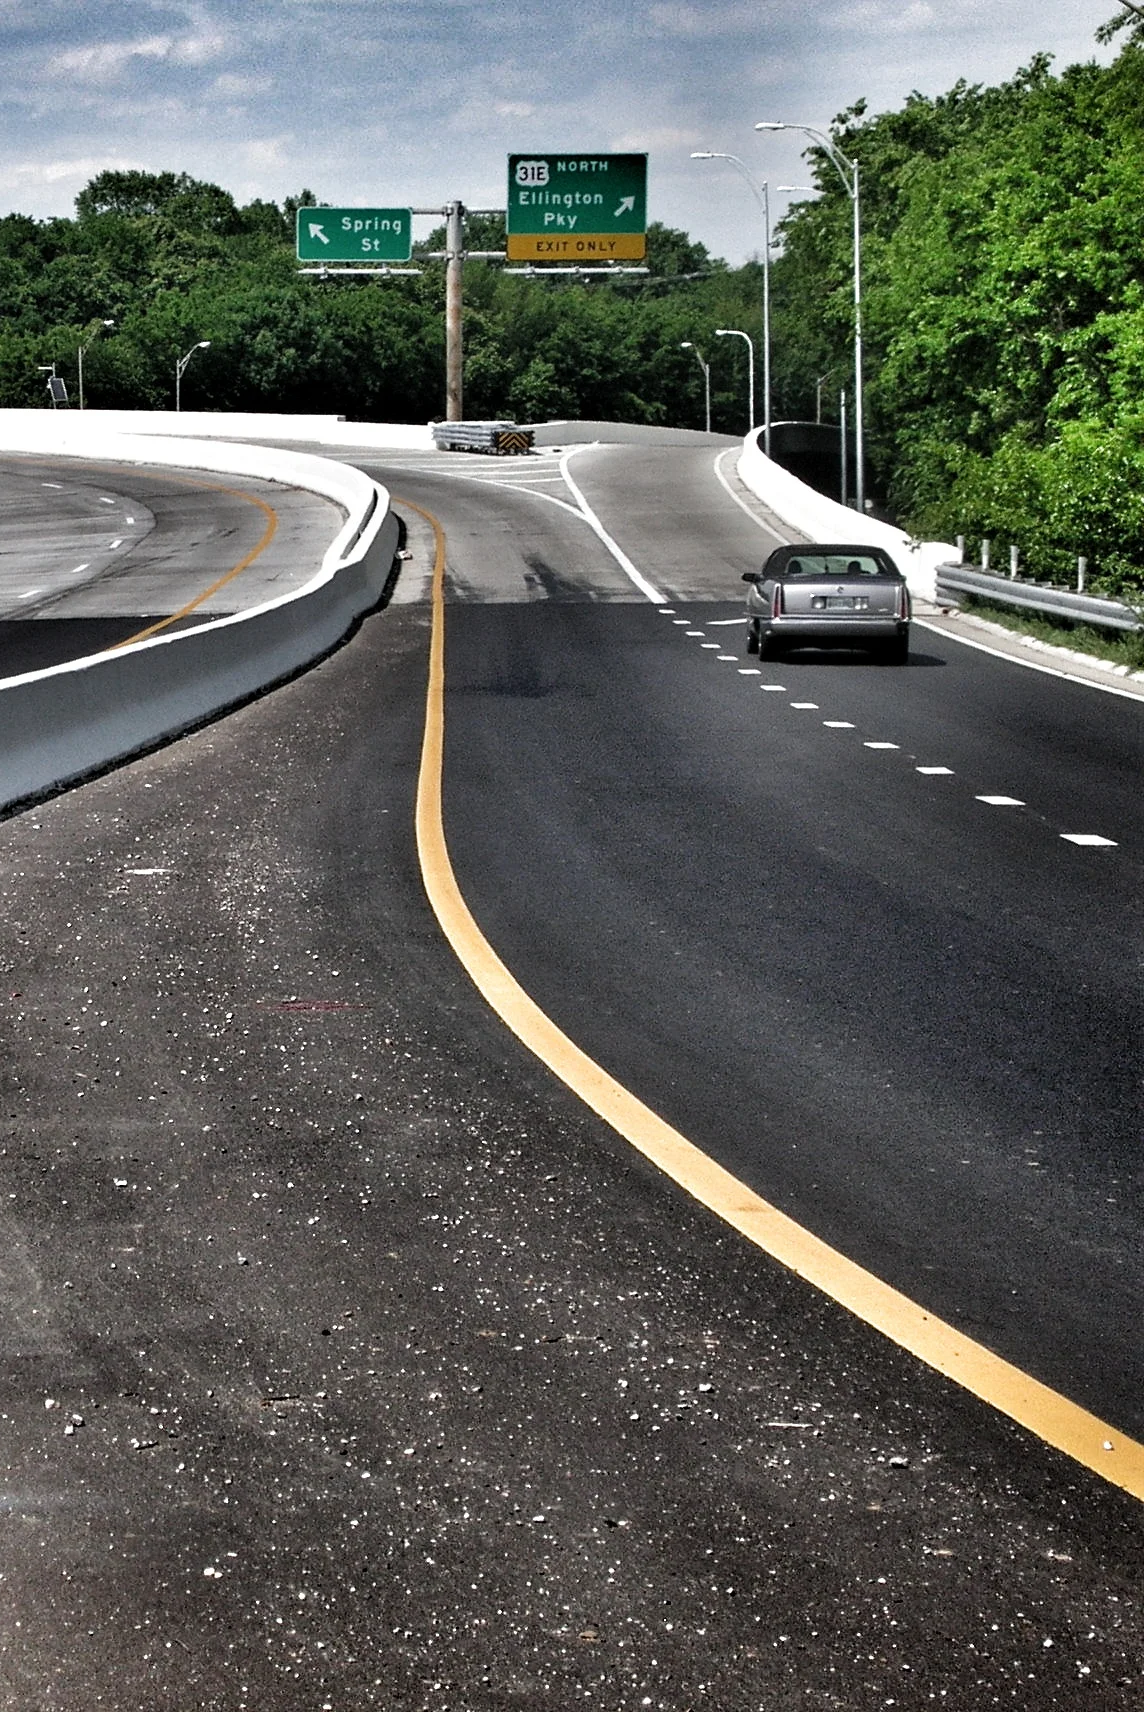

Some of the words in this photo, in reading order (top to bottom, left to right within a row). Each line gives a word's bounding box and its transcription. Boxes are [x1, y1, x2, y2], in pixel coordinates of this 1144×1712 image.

[518, 166, 546, 181] 31E
[557, 161, 608, 172] NORTH
[519, 191, 604, 208] Ellington
[341, 217, 402, 235] Spring
[544, 212, 578, 229] Pky
[361, 238, 380, 251] St
[536, 241, 570, 252] EXIT
[576, 241, 617, 252] ONLY
